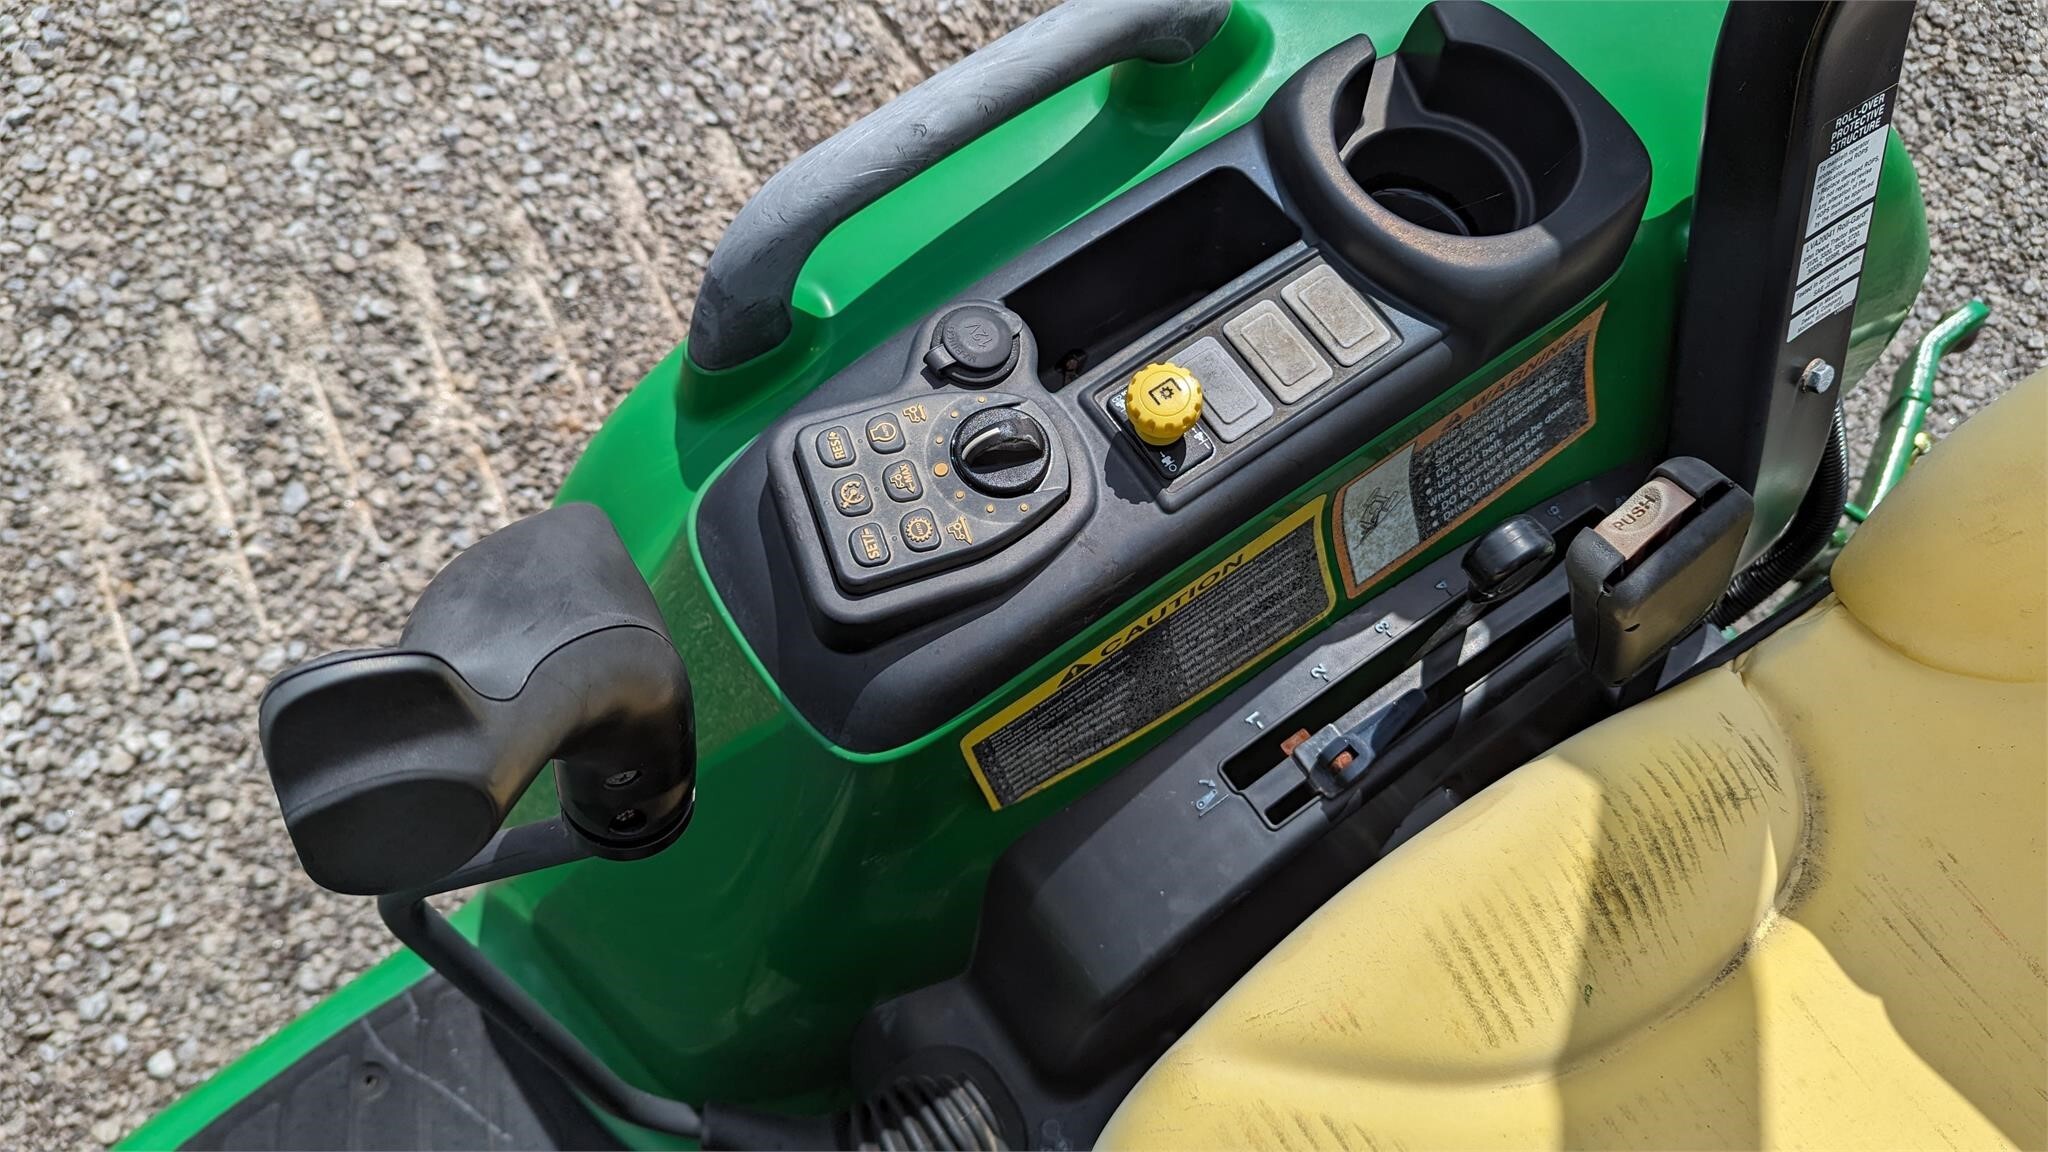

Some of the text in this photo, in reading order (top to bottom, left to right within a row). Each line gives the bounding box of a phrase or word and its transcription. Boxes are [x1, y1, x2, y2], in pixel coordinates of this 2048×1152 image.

[1831, 104, 1885, 143] PROTECTIVE
[1835, 93, 1886, 129] ROLL-OVER
[1830, 117, 1882, 154] STRUCTURE
[964, 323, 993, 349] 12V
[1427, 481, 1456, 508] When
[1458, 450, 1502, 486] structure
[1505, 430, 1528, 452] must
[1531, 419, 1542, 434] be
[1435, 462, 1449, 478] Do
[1452, 449, 1468, 466] not
[1471, 430, 1495, 456] jump
[1437, 470, 1456, 489] Use
[1459, 453, 1478, 473] seat
[1441, 493, 1456, 511] DO
[1459, 476, 1480, 497] NOT
[1483, 463, 1500, 480] use
[1503, 446, 1522, 466] seat
[1443, 497, 1468, 521] Drive
[1612, 494, 1656, 530] PUSH
[1100, 553, 1244, 657] CAUTION
